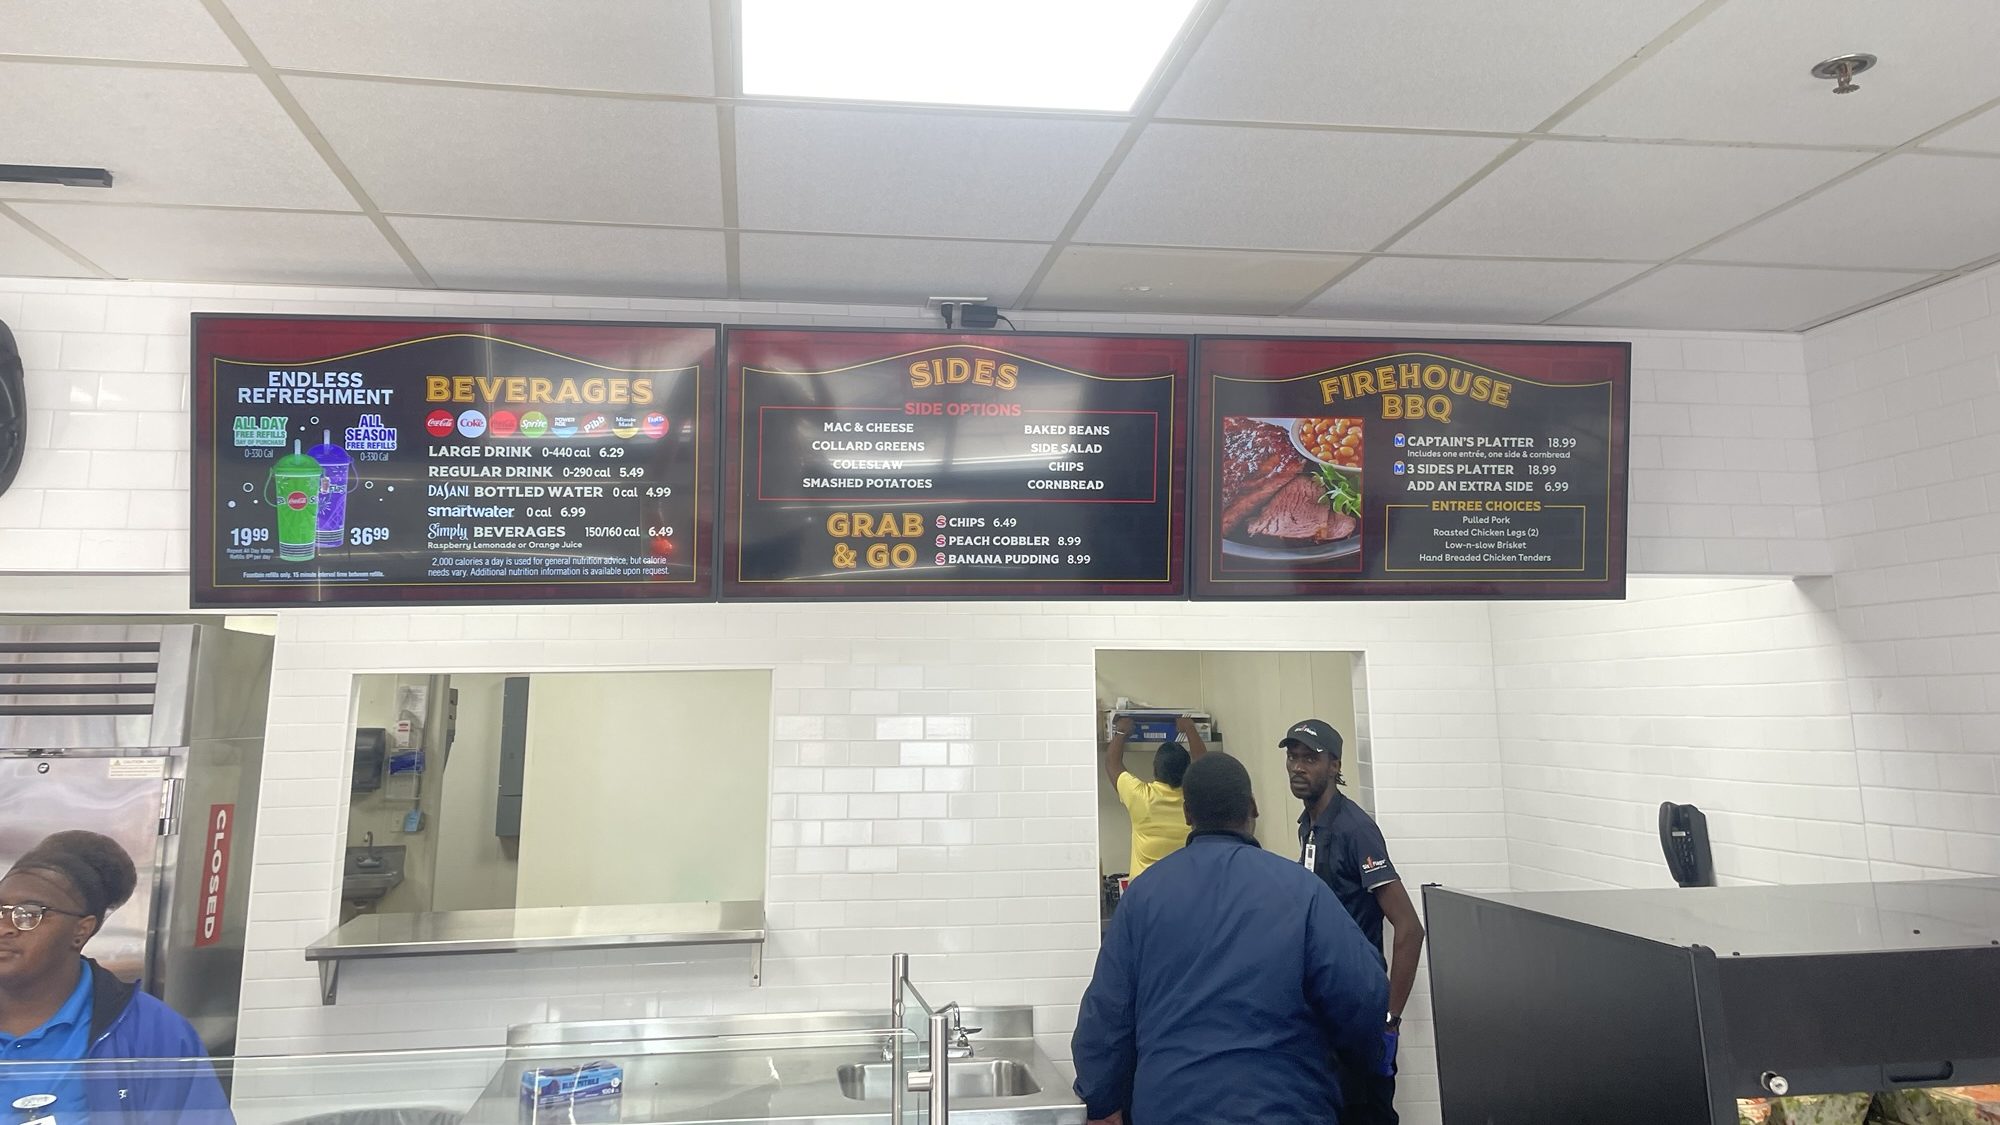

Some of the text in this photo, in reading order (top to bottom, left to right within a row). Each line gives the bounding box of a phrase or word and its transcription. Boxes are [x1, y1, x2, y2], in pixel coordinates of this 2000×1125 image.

[268, 371, 363, 388] ENDLESS
[908, 357, 1020, 391] SIDES
[426, 375, 654, 404] BEVERAGES
[1319, 363, 1513, 409] FIREHOUSE
[238, 387, 394, 405] REFRESHMENT
[904, 403, 1022, 417] SIDE OPTIONS
[1382, 394, 1452, 423] BBQ
[234, 417, 287, 430] ALL DAY
[360, 415, 383, 428] ALL
[460, 418, 484, 428] Coke
[521, 419, 546, 429] Sprite
[584, 416, 606, 433] Pibb
[824, 422, 914, 434] MAC & CHEESE
[1024, 425, 1110, 436] BAKED BEANS
[347, 429, 395, 441] SEASON
[812, 440, 925, 452] COLLARD GREENS
[1477, 437, 1534, 447] PLATTER
[1548, 438, 1576, 448] 18.99
[428, 446, 624, 458] LARGE DRINK 0-440 cal 6.29
[1030, 443, 1102, 454] SIDE SALAD
[1407, 450, 1441, 458] Includes
[1504, 450, 1520, 458] side
[832, 460, 904, 470] COLESLAW
[1048, 461, 1084, 472] CHIPS
[1407, 464, 1556, 475] 3 SIDES PLATTER 18.99
[428, 466, 644, 478] REGULAR DRINK 0-290 cal 5.49
[803, 478, 932, 489] SMASHED POTATOES
[1027, 480, 1104, 491] CORNBREAD
[1407, 481, 1569, 492] ADD AN EXTRA SIDE 6.99
[428, 482, 671, 500] DASANI BOTTLED WATER 0 cal 4.99
[428, 505, 586, 518] smartwater 0 cal 6.99
[1432, 501, 1542, 512] ENTREE CHOICES
[826, 512, 925, 538] GRAB
[949, 517, 1017, 528] CHIPS 6.49
[1462, 516, 1510, 524] Pulled Pork
[427, 522, 673, 540] Simply BEVERAGES 150/160 cal 6.49
[1433, 528, 1539, 538] Roasted Chicken Legs (2)
[427, 542, 471, 550] Raspberry
[528, 542, 560, 550] Orange
[949, 536, 1081, 546] PEACH COBBLER 8.99
[1445, 541, 1527, 549] Low-n-slow Brisket
[832, 542, 918, 569] & GO
[949, 554, 1091, 564] BANANA PUDDING 8.99
[1419, 554, 1551, 562] Hand Breaded Chicken Tenders
[432, 557, 453, 566] 2,000
[455, 557, 483, 566] calories
[491, 557, 503, 567] day
[506, 557, 512, 566] is
[514, 557, 531, 566] used
[533, 557, 543, 566] for
[544, 557, 570, 566] general
[630, 556, 641, 565] but
[642, 556, 667, 564] calorie
[428, 568, 449, 576] needs
[470, 567, 506, 576] Additional
[509, 567, 538, 576] nutrition
[540, 567, 580, 576] information
[582, 567, 589, 575] is
[590, 567, 621, 575] available
[623, 568, 640, 576] upon
[204, 809, 226, 939] CLOSED
